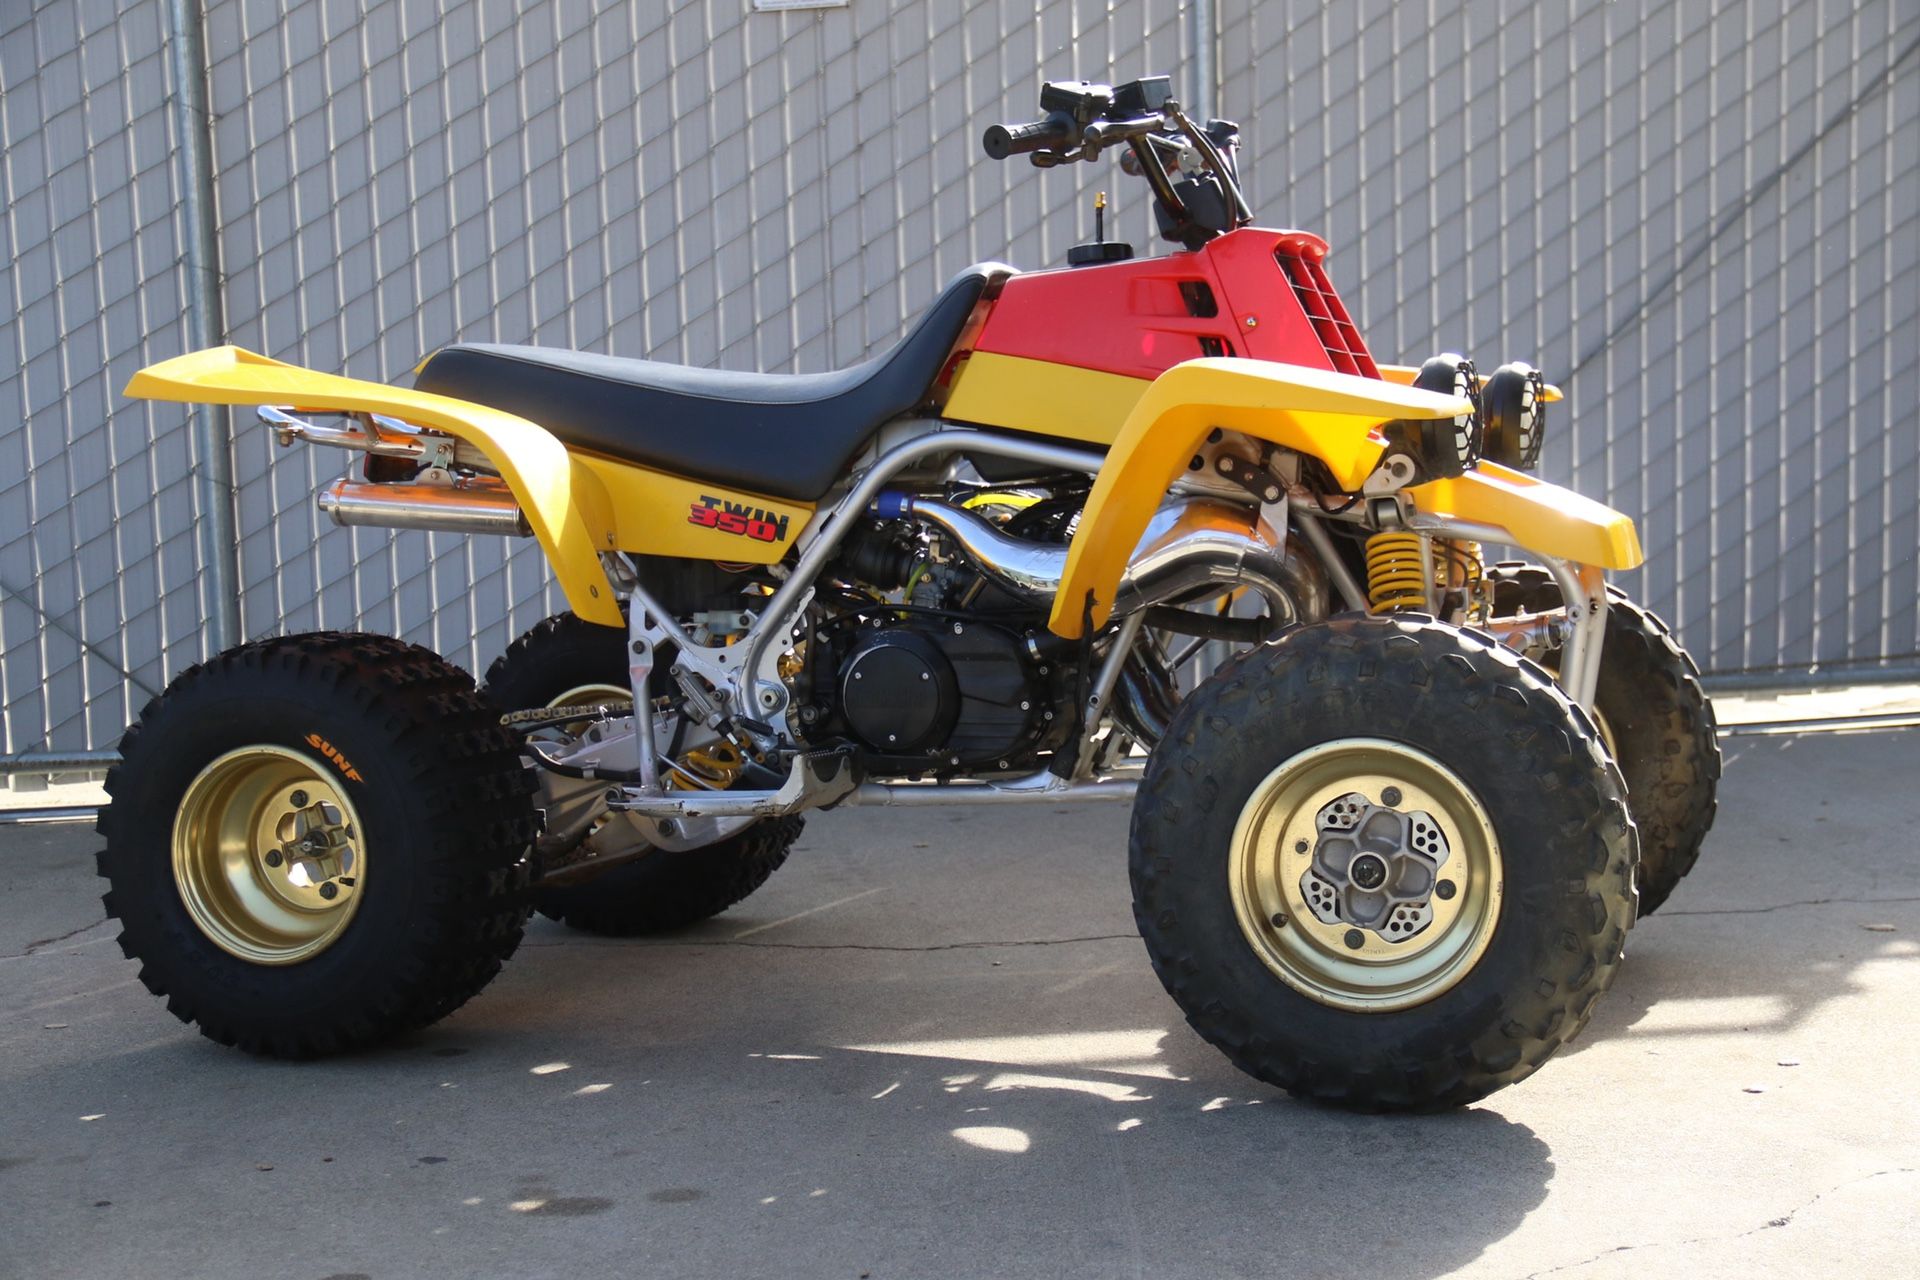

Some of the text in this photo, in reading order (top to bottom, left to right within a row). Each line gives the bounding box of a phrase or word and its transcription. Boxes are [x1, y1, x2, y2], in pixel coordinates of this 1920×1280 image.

[688, 504, 777, 542] 350
[700, 495, 789, 541] TWIN
[304, 734, 364, 783] SUNF
